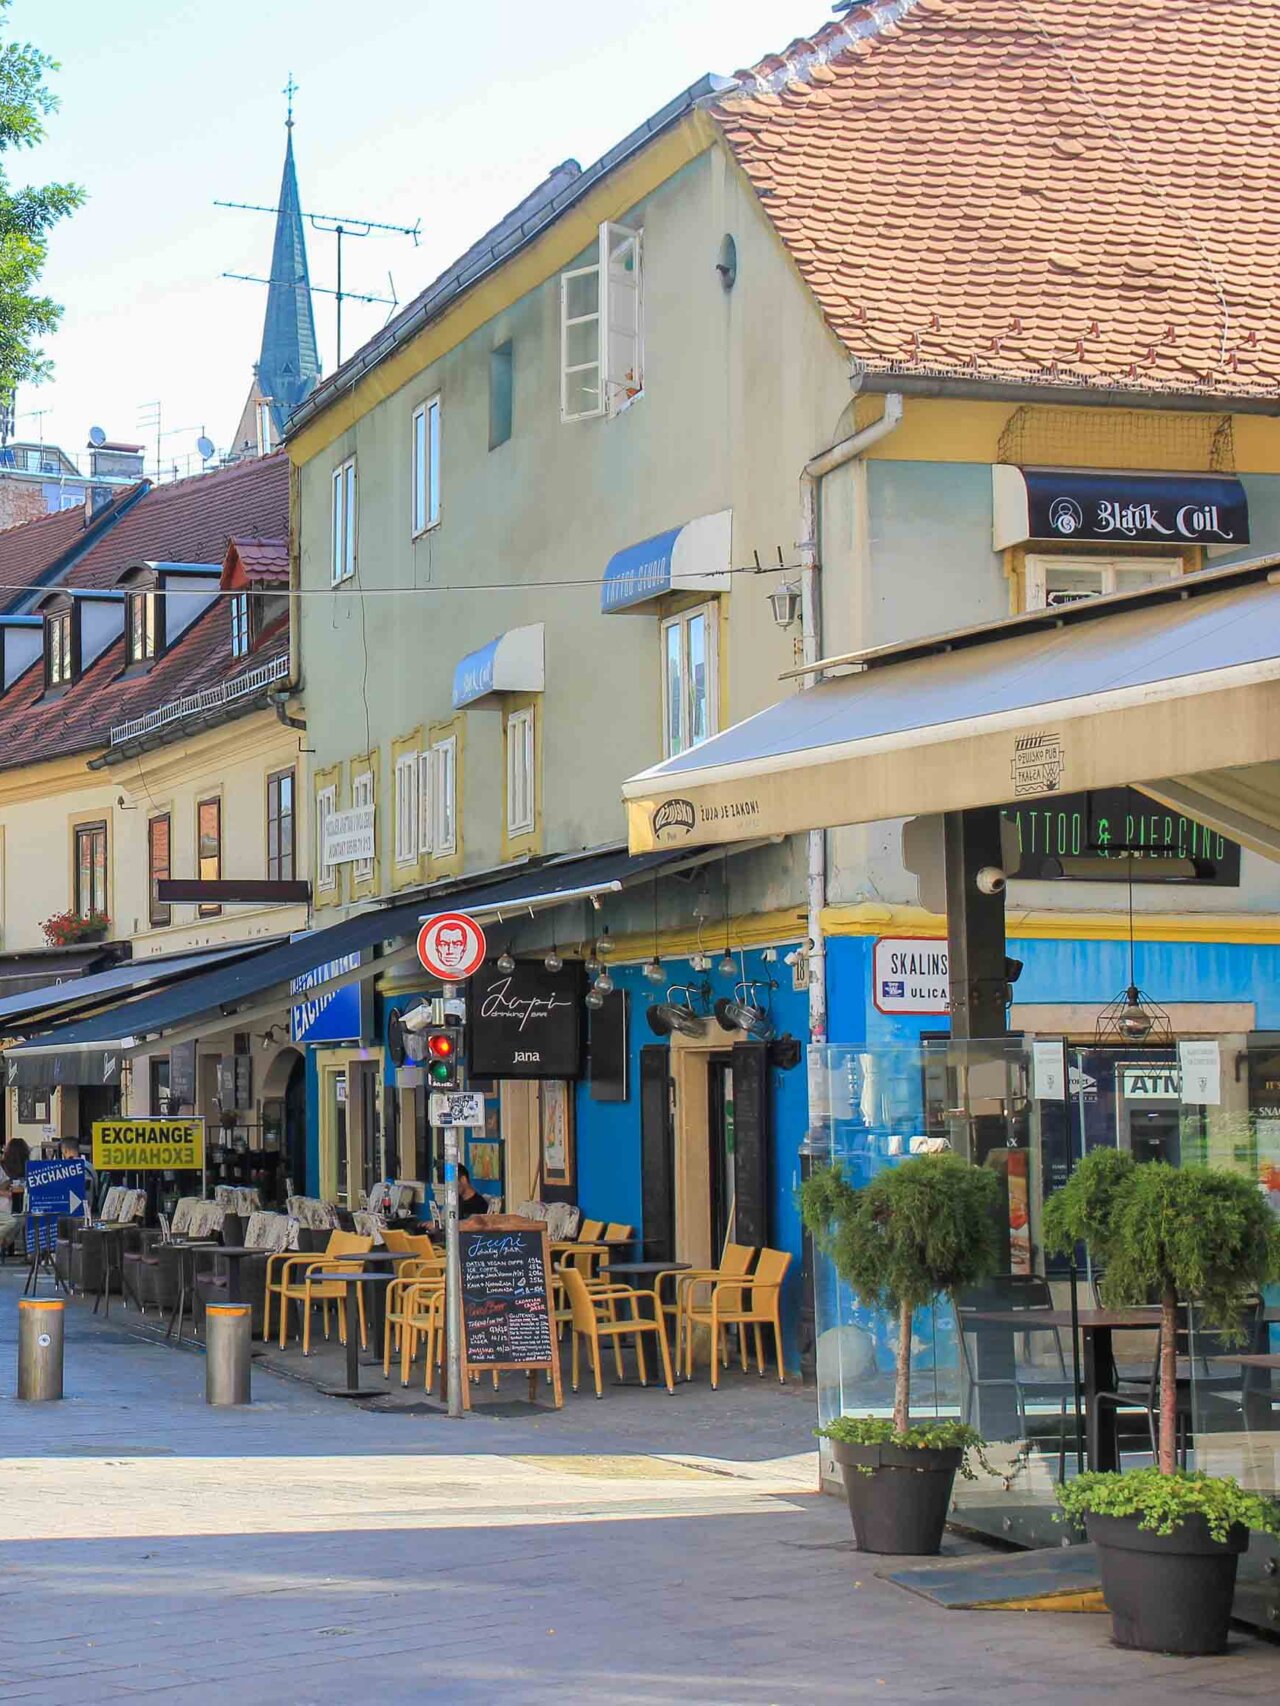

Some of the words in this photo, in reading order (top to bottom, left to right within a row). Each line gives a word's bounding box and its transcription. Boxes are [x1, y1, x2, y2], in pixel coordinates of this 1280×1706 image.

[1093, 500, 1175, 536] Black
[1176, 505, 1233, 539] Coil
[701, 804, 718, 821] ŽUJA
[721, 806, 729, 818] JE
[731, 801, 760, 817] ZAKON!
[796, 960, 805, 981] 18
[911, 988, 947, 998] ULICA
[101, 1126, 194, 1144] EXCHANGE
[28, 1163, 83, 1188] EXCHANGE
